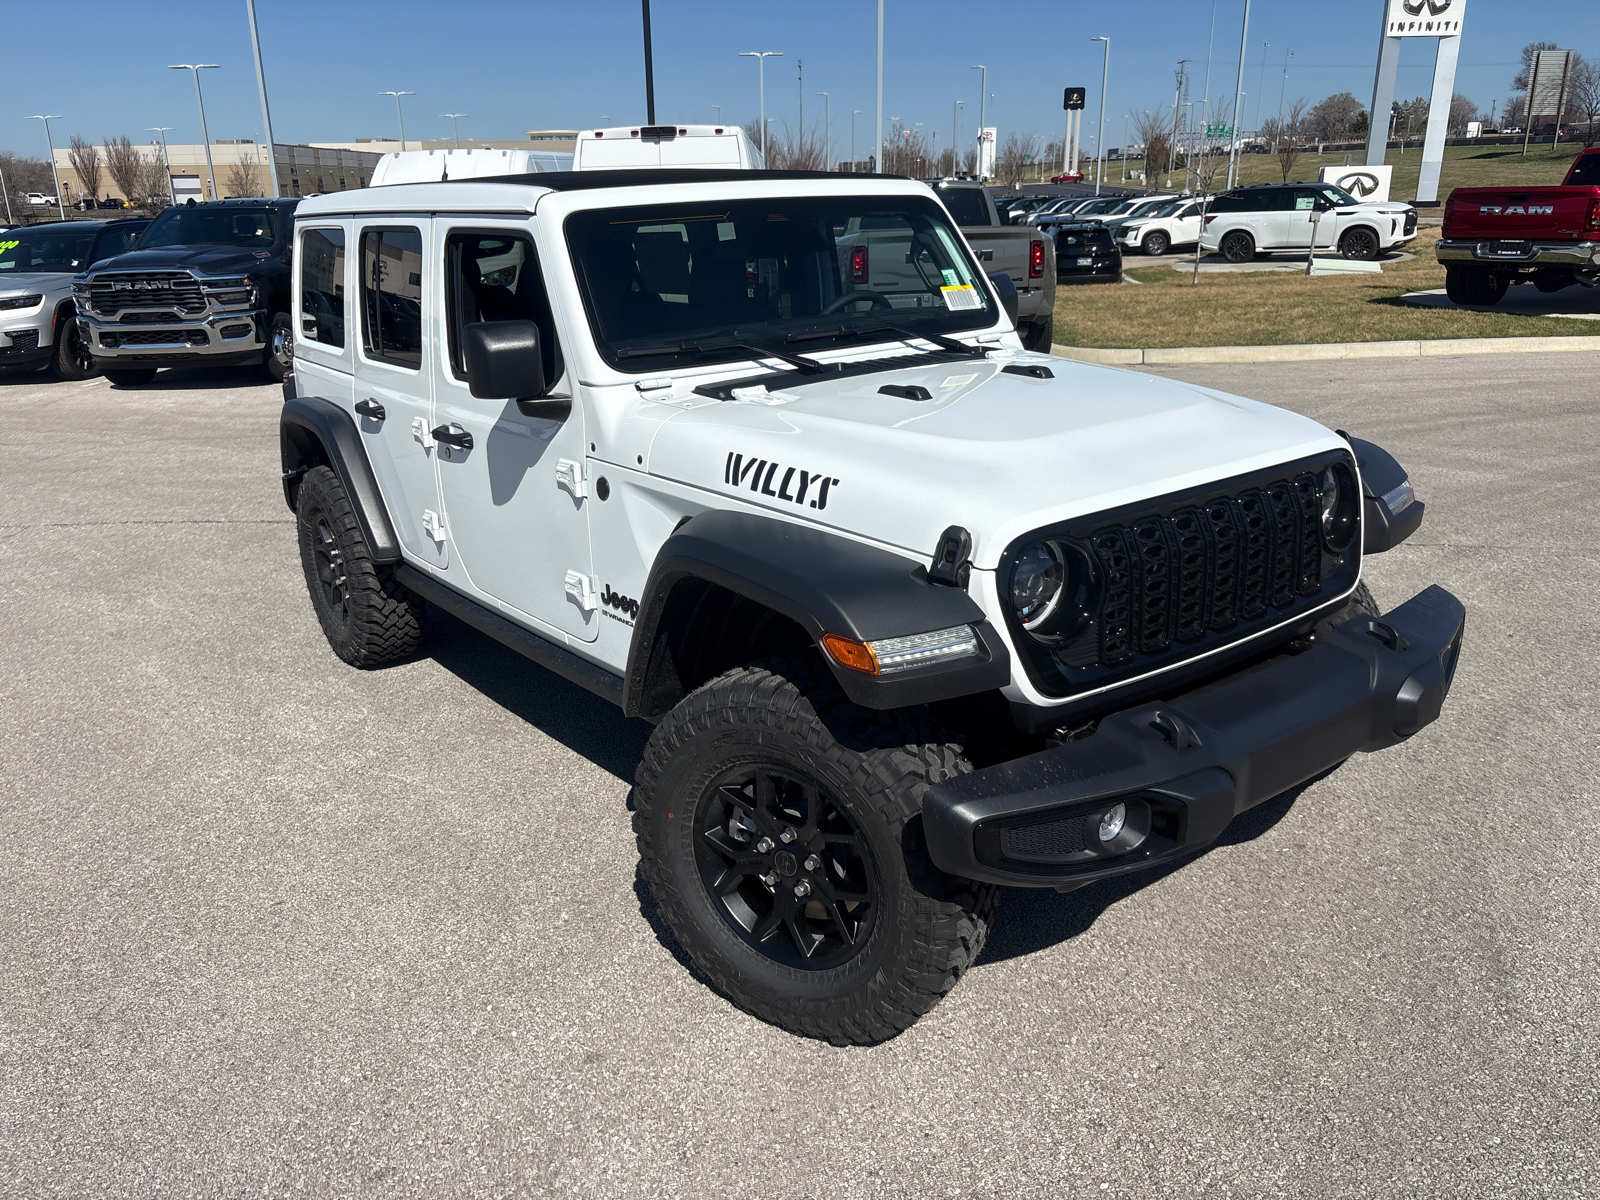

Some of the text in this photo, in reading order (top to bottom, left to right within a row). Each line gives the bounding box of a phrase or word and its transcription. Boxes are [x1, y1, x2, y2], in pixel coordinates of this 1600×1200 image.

[1390, 20, 1458, 32] INFINITI
[1480, 205, 1553, 216] RAM
[115, 281, 169, 290] RAM
[724, 451, 840, 510] WILLYS
[600, 582, 640, 619] Jeep
